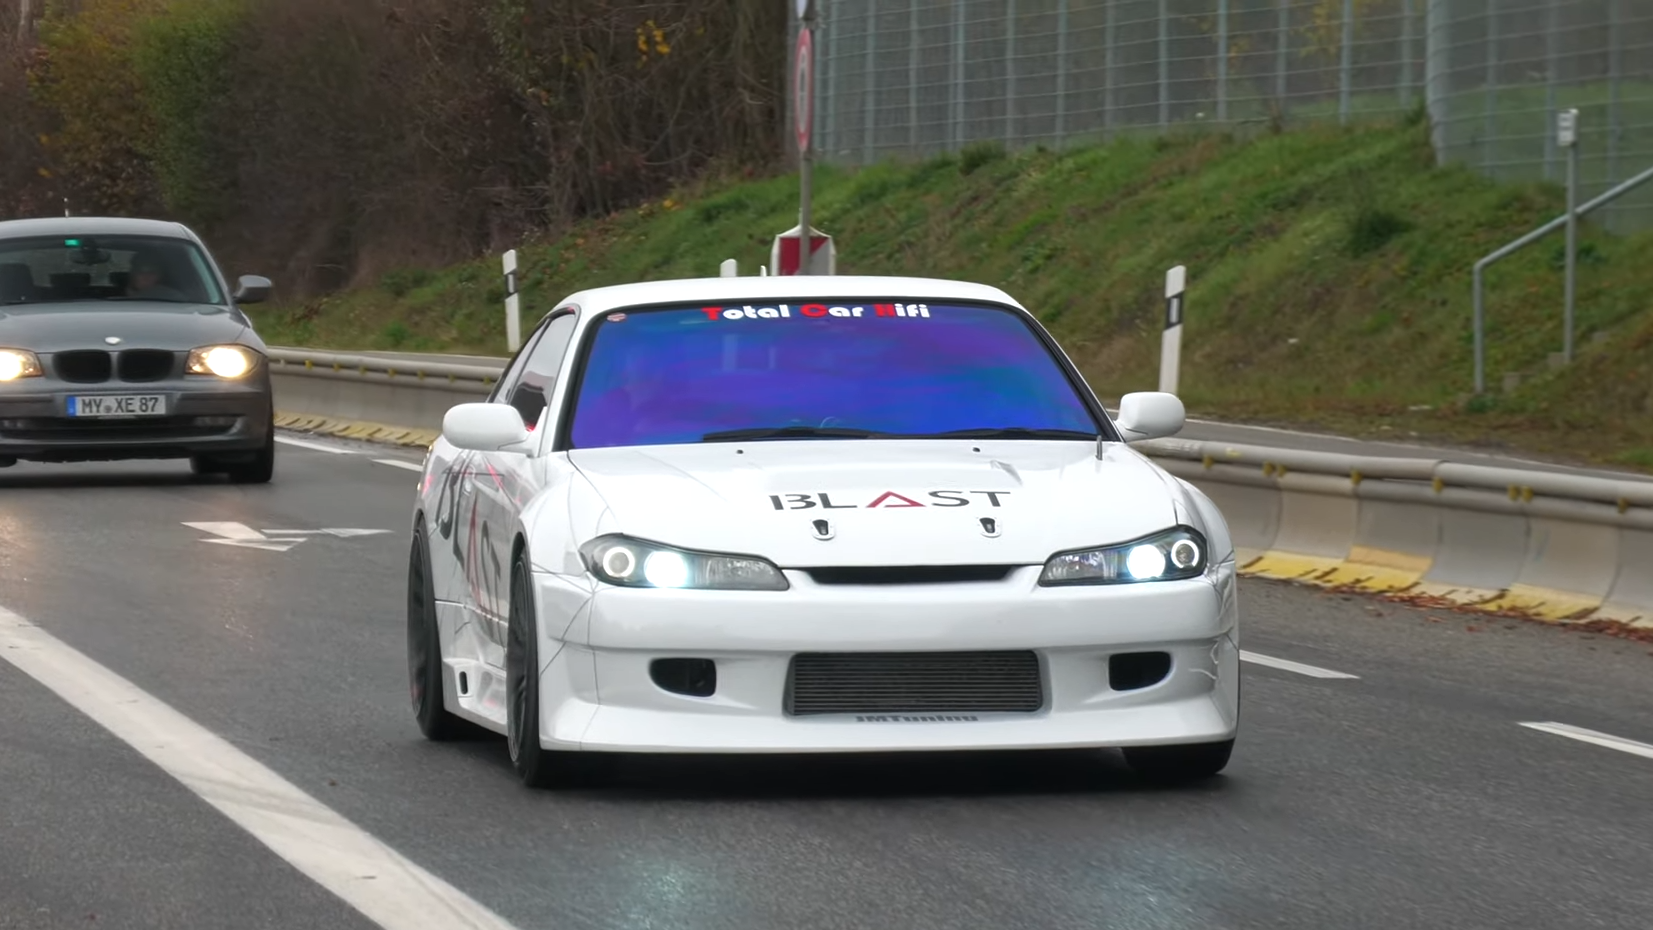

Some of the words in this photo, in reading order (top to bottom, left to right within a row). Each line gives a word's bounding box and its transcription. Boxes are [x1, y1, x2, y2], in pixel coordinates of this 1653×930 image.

[702, 304, 790, 320] Total
[800, 303, 865, 318] Car
[873, 303, 930, 318] Hifi
[114, 397, 136, 413] XE
[139, 397, 159, 413] 87
[768, 490, 1011, 511] BLAST
